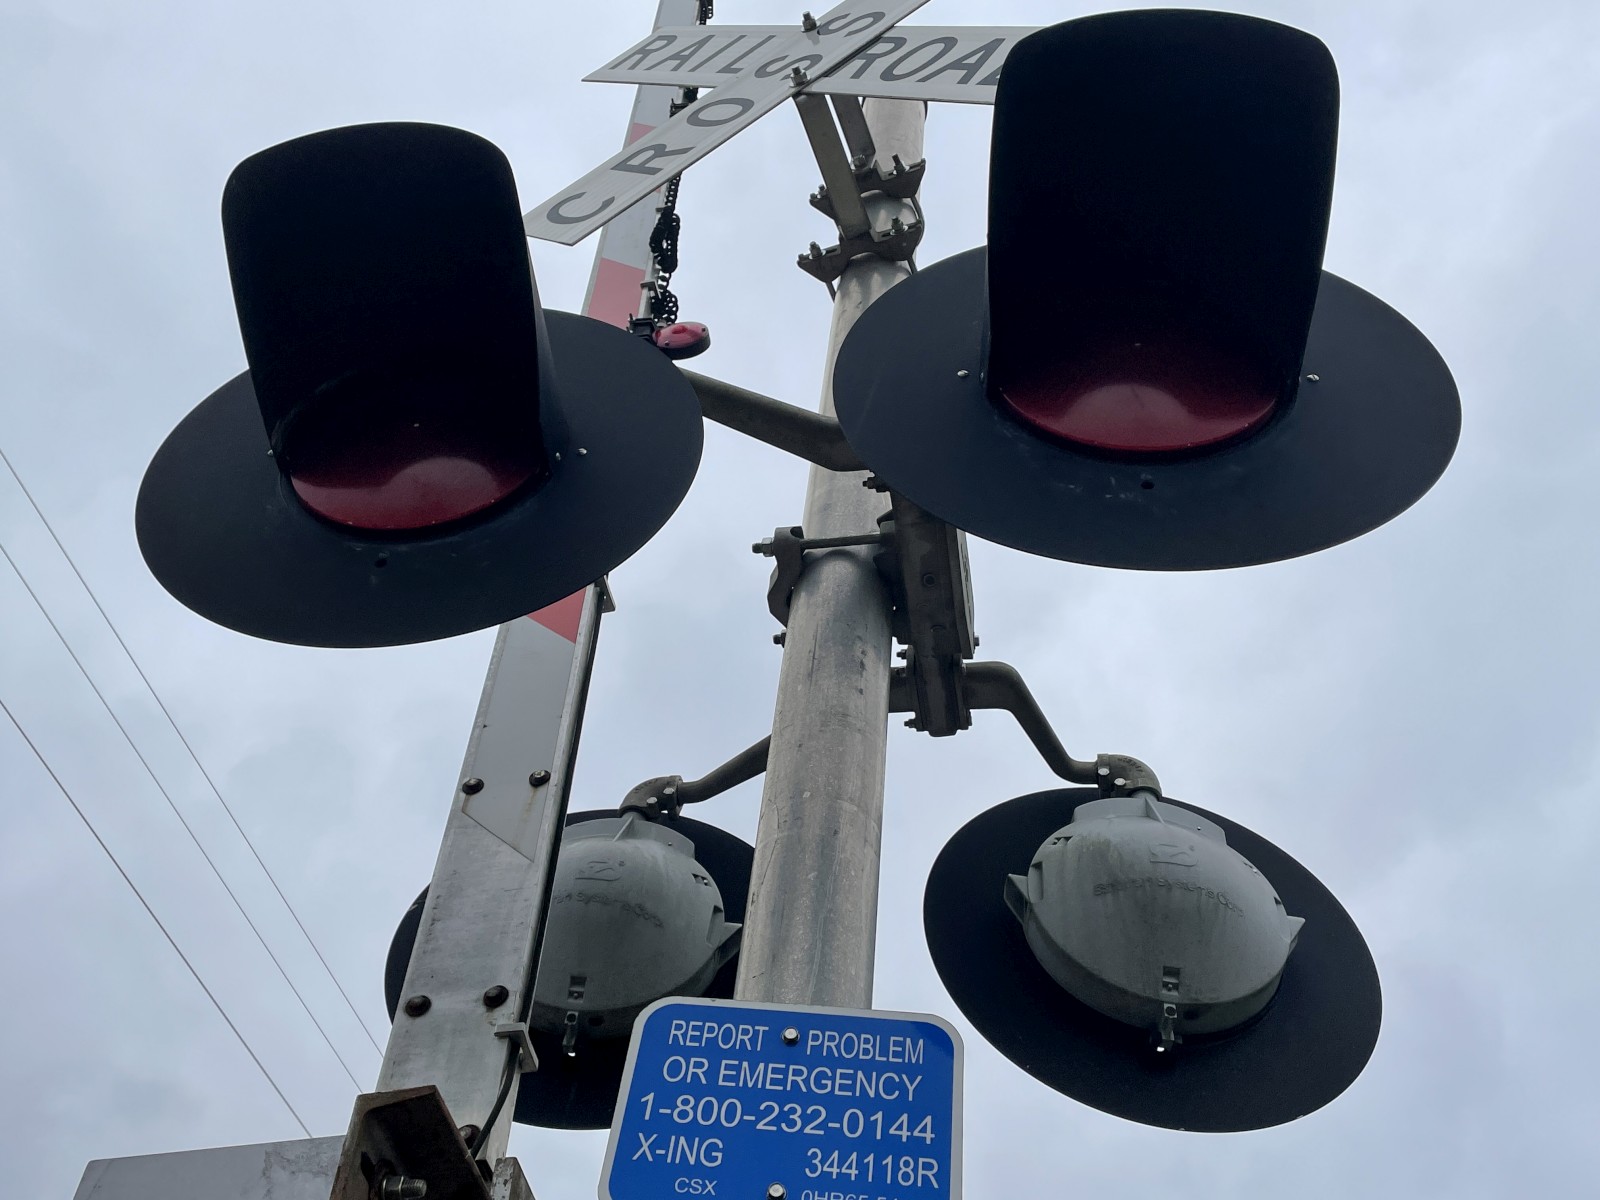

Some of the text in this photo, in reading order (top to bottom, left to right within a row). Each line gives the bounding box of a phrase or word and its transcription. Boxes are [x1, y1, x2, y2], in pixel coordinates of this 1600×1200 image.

[608, 35, 1004, 86] RAIL ROA
[668, 1019, 925, 1065] REPORT PROBLEM
[662, 1055, 923, 1102] OR EMERGENCY
[639, 1092, 936, 1145] 1-800-232-0144
[632, 1132, 939, 1189] X-ING 344118R
[674, 1177, 717, 1196] CSX
